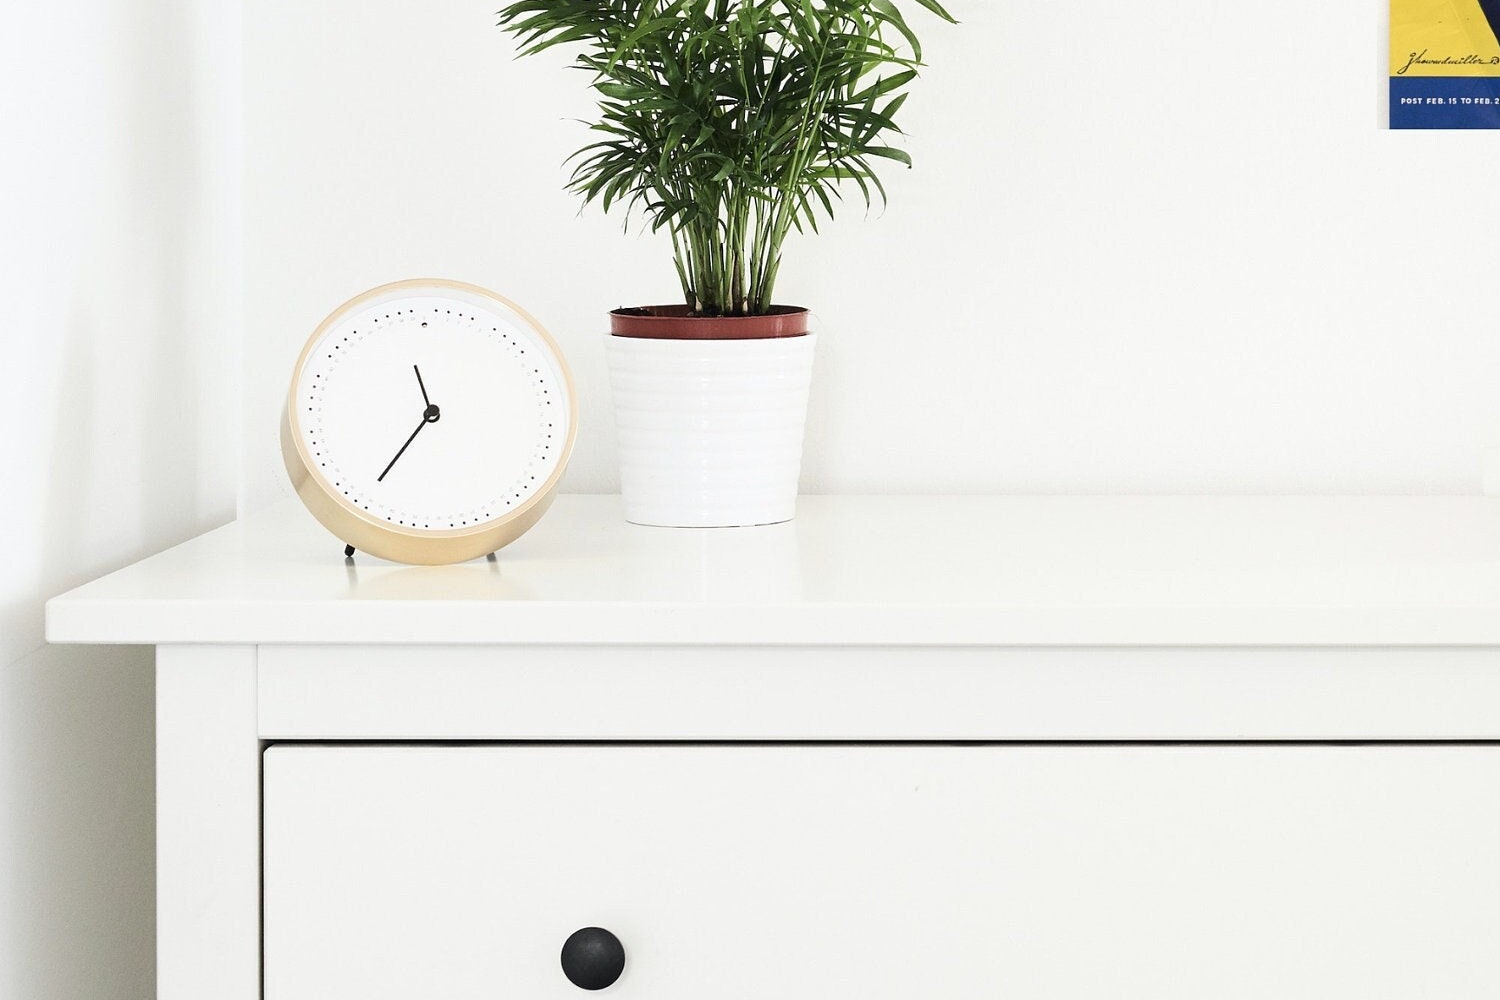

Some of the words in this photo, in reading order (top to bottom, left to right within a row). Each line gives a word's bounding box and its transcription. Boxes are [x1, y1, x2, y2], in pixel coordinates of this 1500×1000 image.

[1400, 97, 1423, 105] POST
[1426, 97, 1446, 105] FEB.
[1448, 97, 1457, 105] 15
[1461, 97, 1472, 105] TO
[1474, 97, 1493, 105] FEB.
